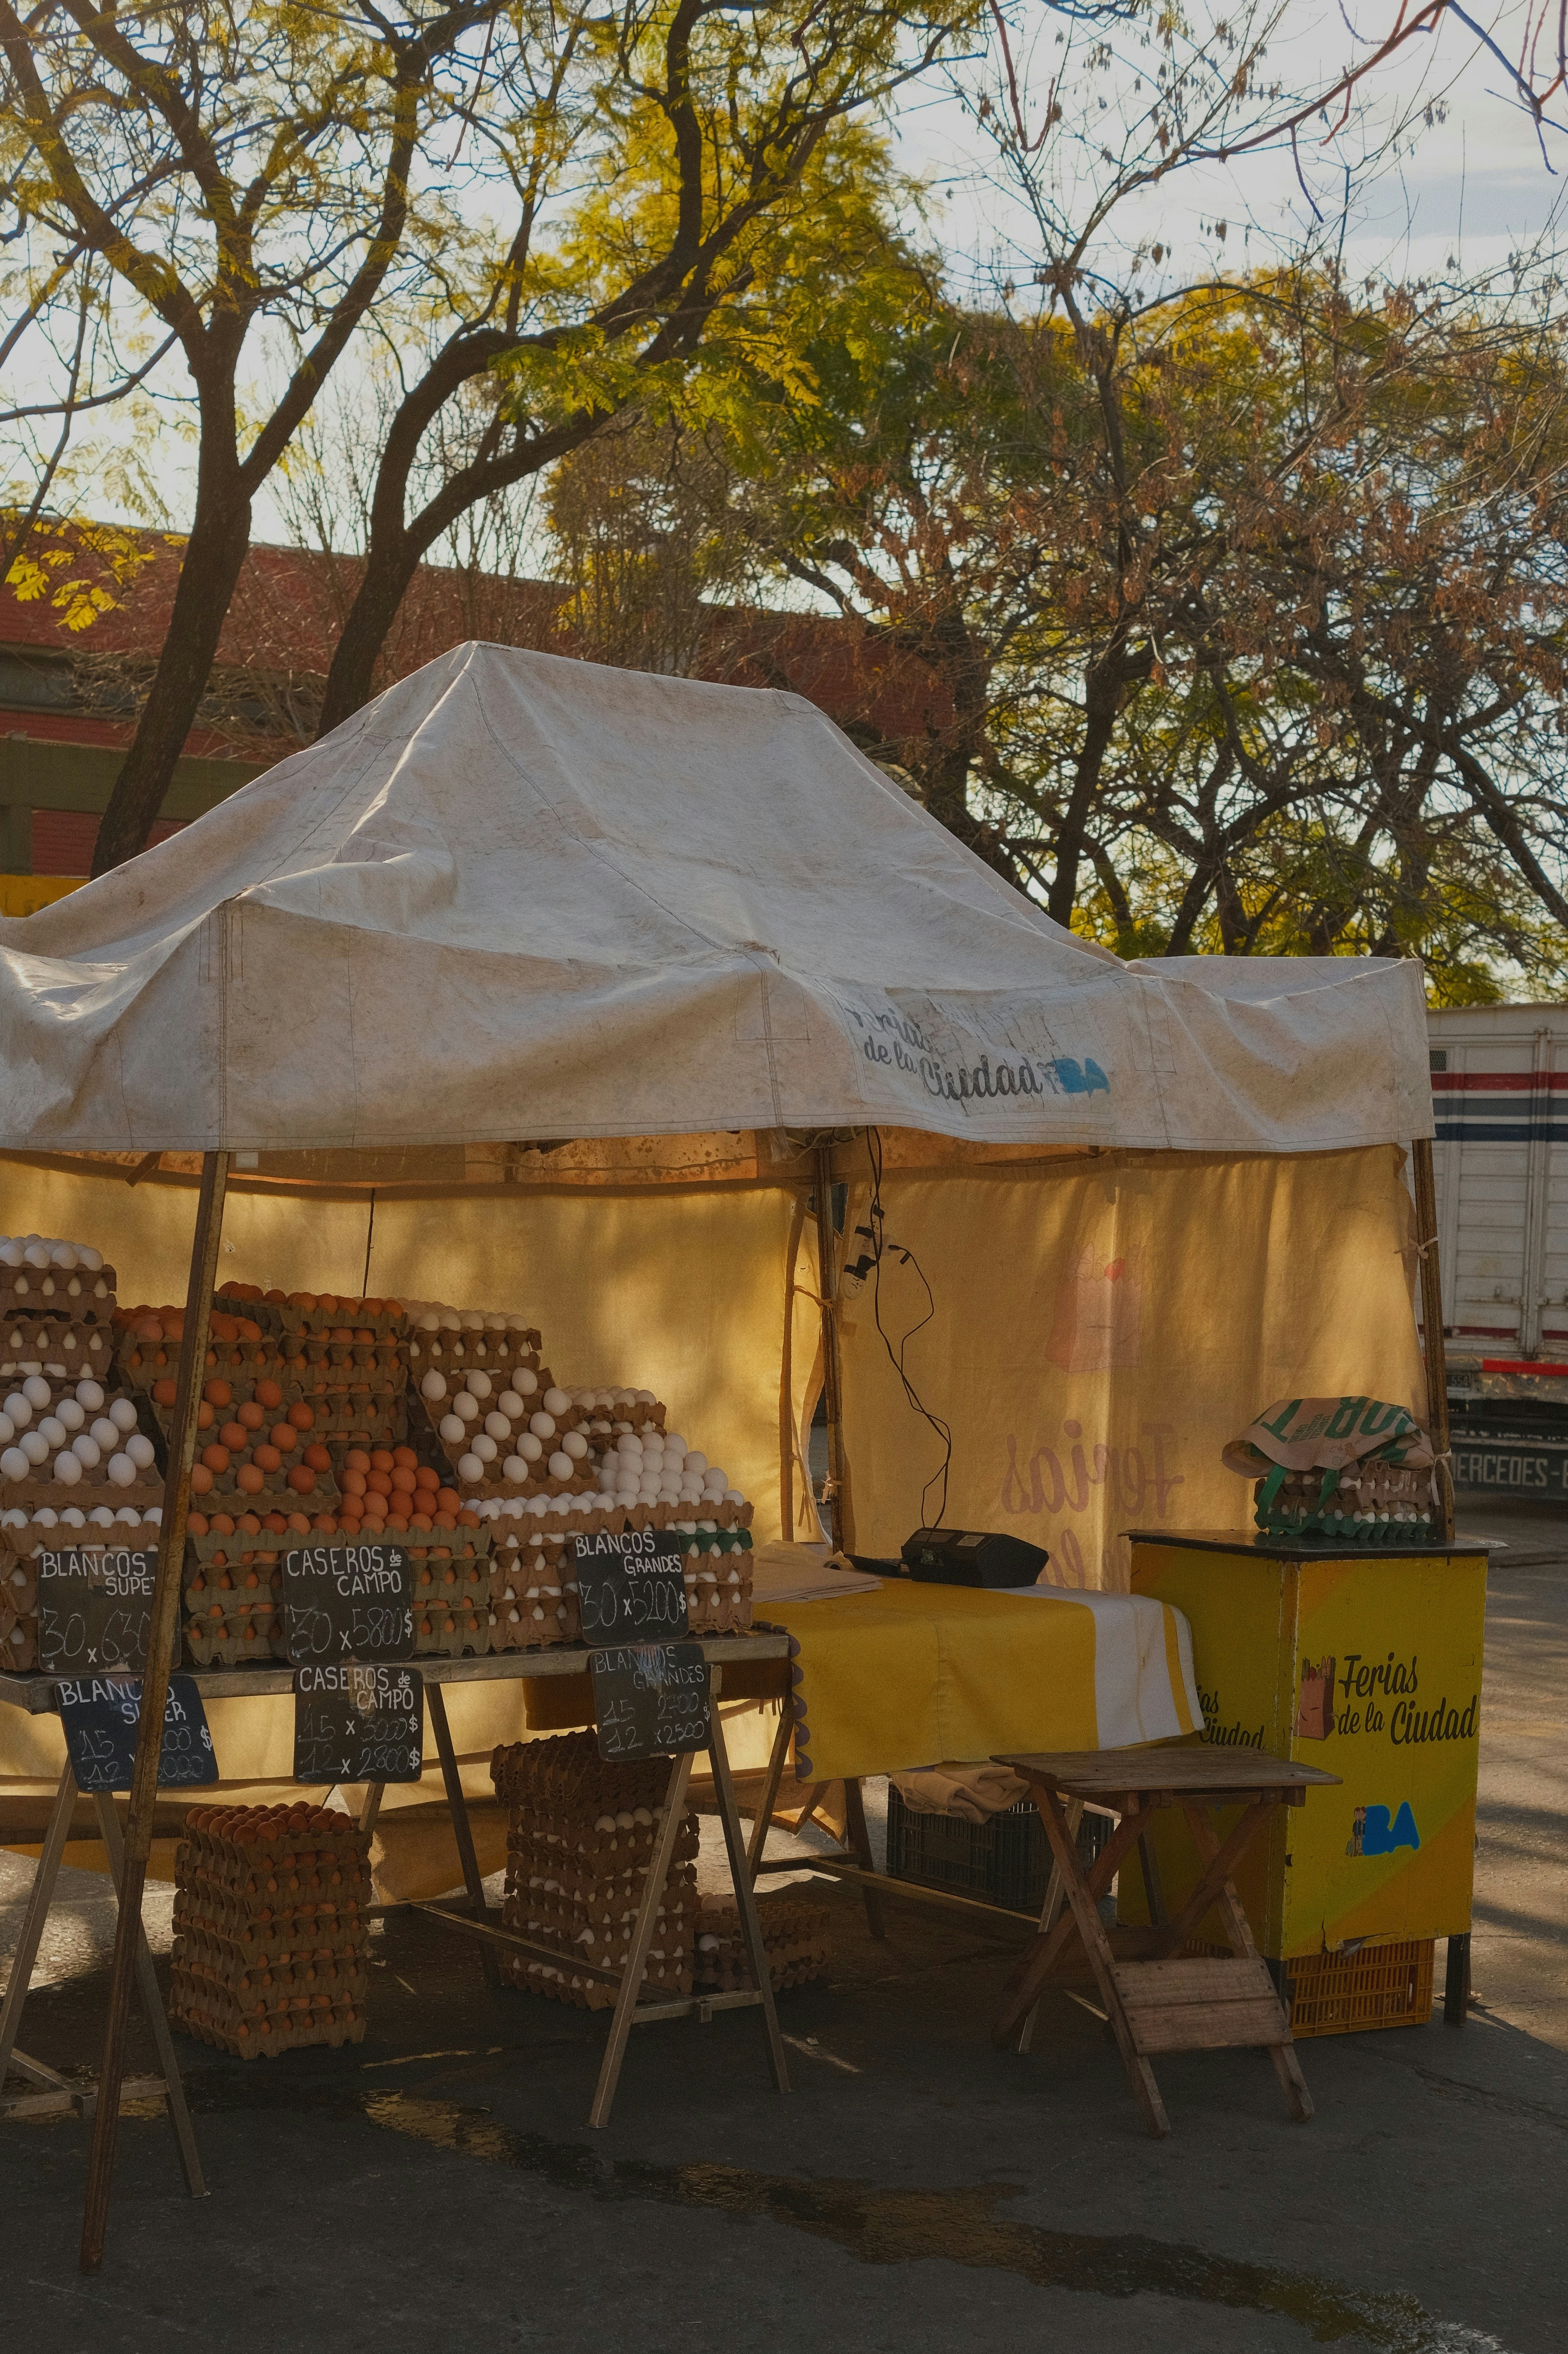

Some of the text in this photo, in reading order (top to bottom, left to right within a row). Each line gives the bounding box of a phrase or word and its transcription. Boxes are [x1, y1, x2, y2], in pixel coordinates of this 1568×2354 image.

[864, 1035, 1043, 1101] de la Ciudad
[576, 1532, 656, 1557] BLANCOS
[41, 1552, 146, 1578] BLANCOS
[287, 1546, 402, 1577] CASEROS de
[624, 1554, 682, 1576] GRANDES
[105, 1576, 155, 1595] SUPE
[337, 1570, 401, 1596] CAMPO
[579, 1580, 617, 1629] 30
[42, 1607, 85, 1658] 30
[290, 1604, 331, 1658] 30
[300, 1667, 411, 1692] CASEROS de
[1338, 1652, 1418, 1699] Ferias
[121, 1701, 186, 1724] SER
[357, 1688, 414, 1710] CAMPO
[602, 1699, 635, 1726] 15
[298, 1713, 336, 1742] 15
[1338, 1695, 1478, 1745] de la Ciudad
[80, 1730, 114, 1760] 15
[605, 1726, 643, 1753] 12
[84, 1761, 129, 1784] 12
